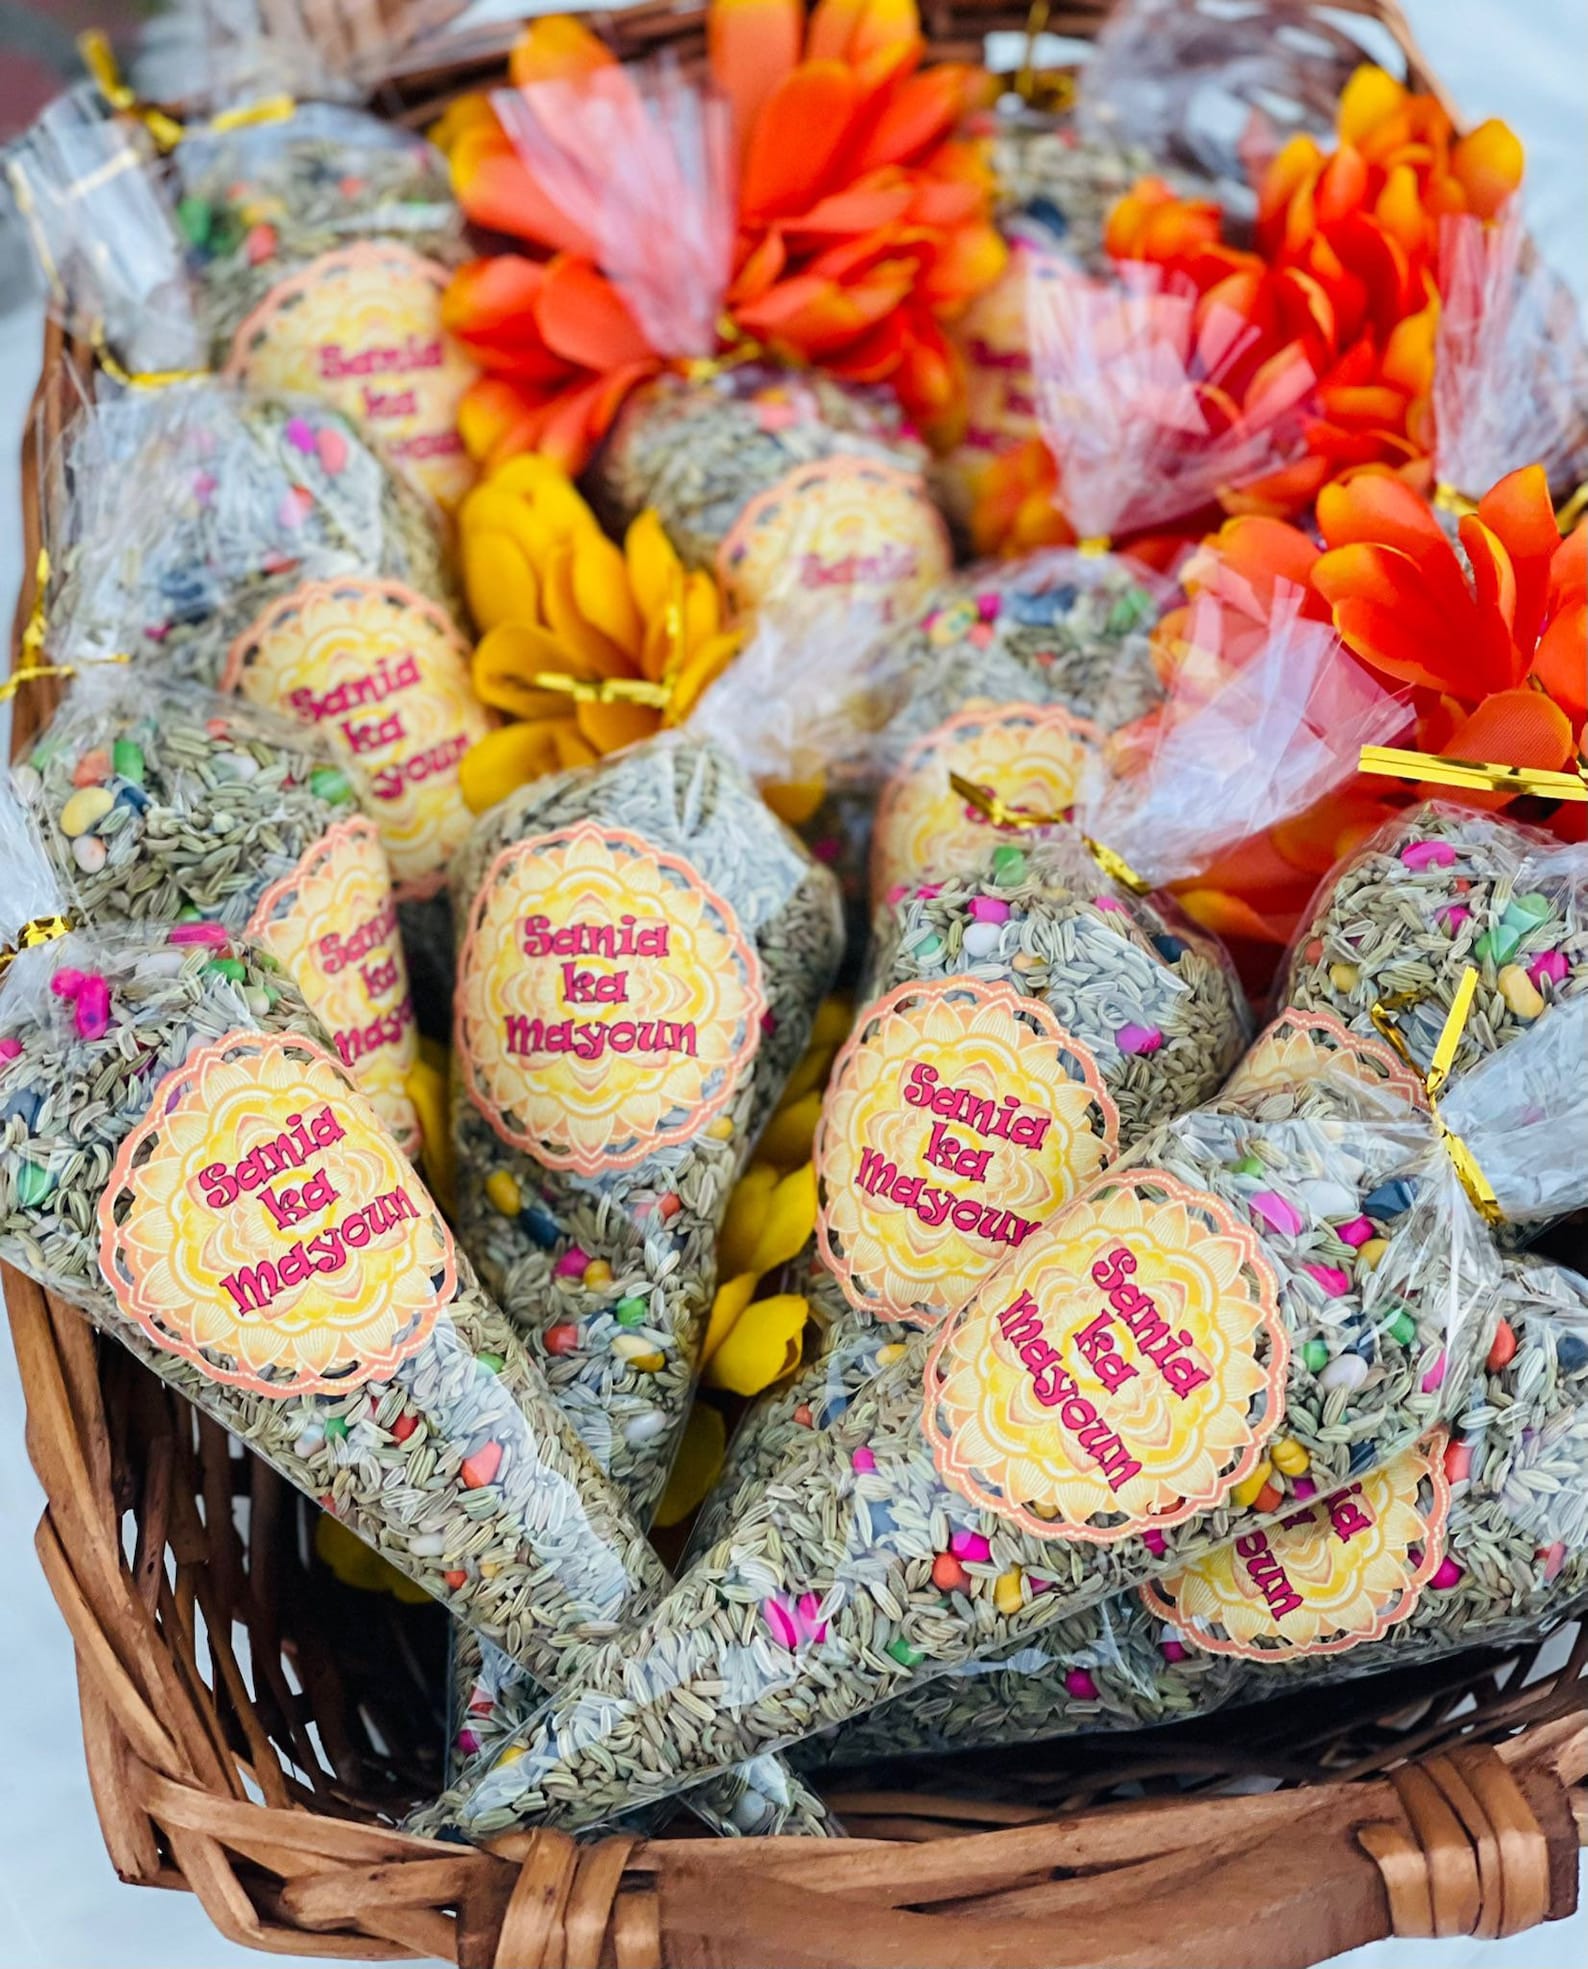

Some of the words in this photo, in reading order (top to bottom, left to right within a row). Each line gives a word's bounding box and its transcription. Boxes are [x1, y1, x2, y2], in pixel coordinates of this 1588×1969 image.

[289, 648, 422, 724] Sania
[341, 709, 406, 754] ka
[523, 915, 670, 959] Sania
[560, 962, 629, 1004] ka
[903, 1063, 1051, 1150] Sania
[198, 1106, 347, 1209] Sania
[923, 1120, 995, 1182] ka
[256, 1168, 339, 1231] ka
[1073, 1309, 1139, 1395] ka
[1092, 1247, 1211, 1400] Sania
[1236, 1530, 1304, 1622] oun
